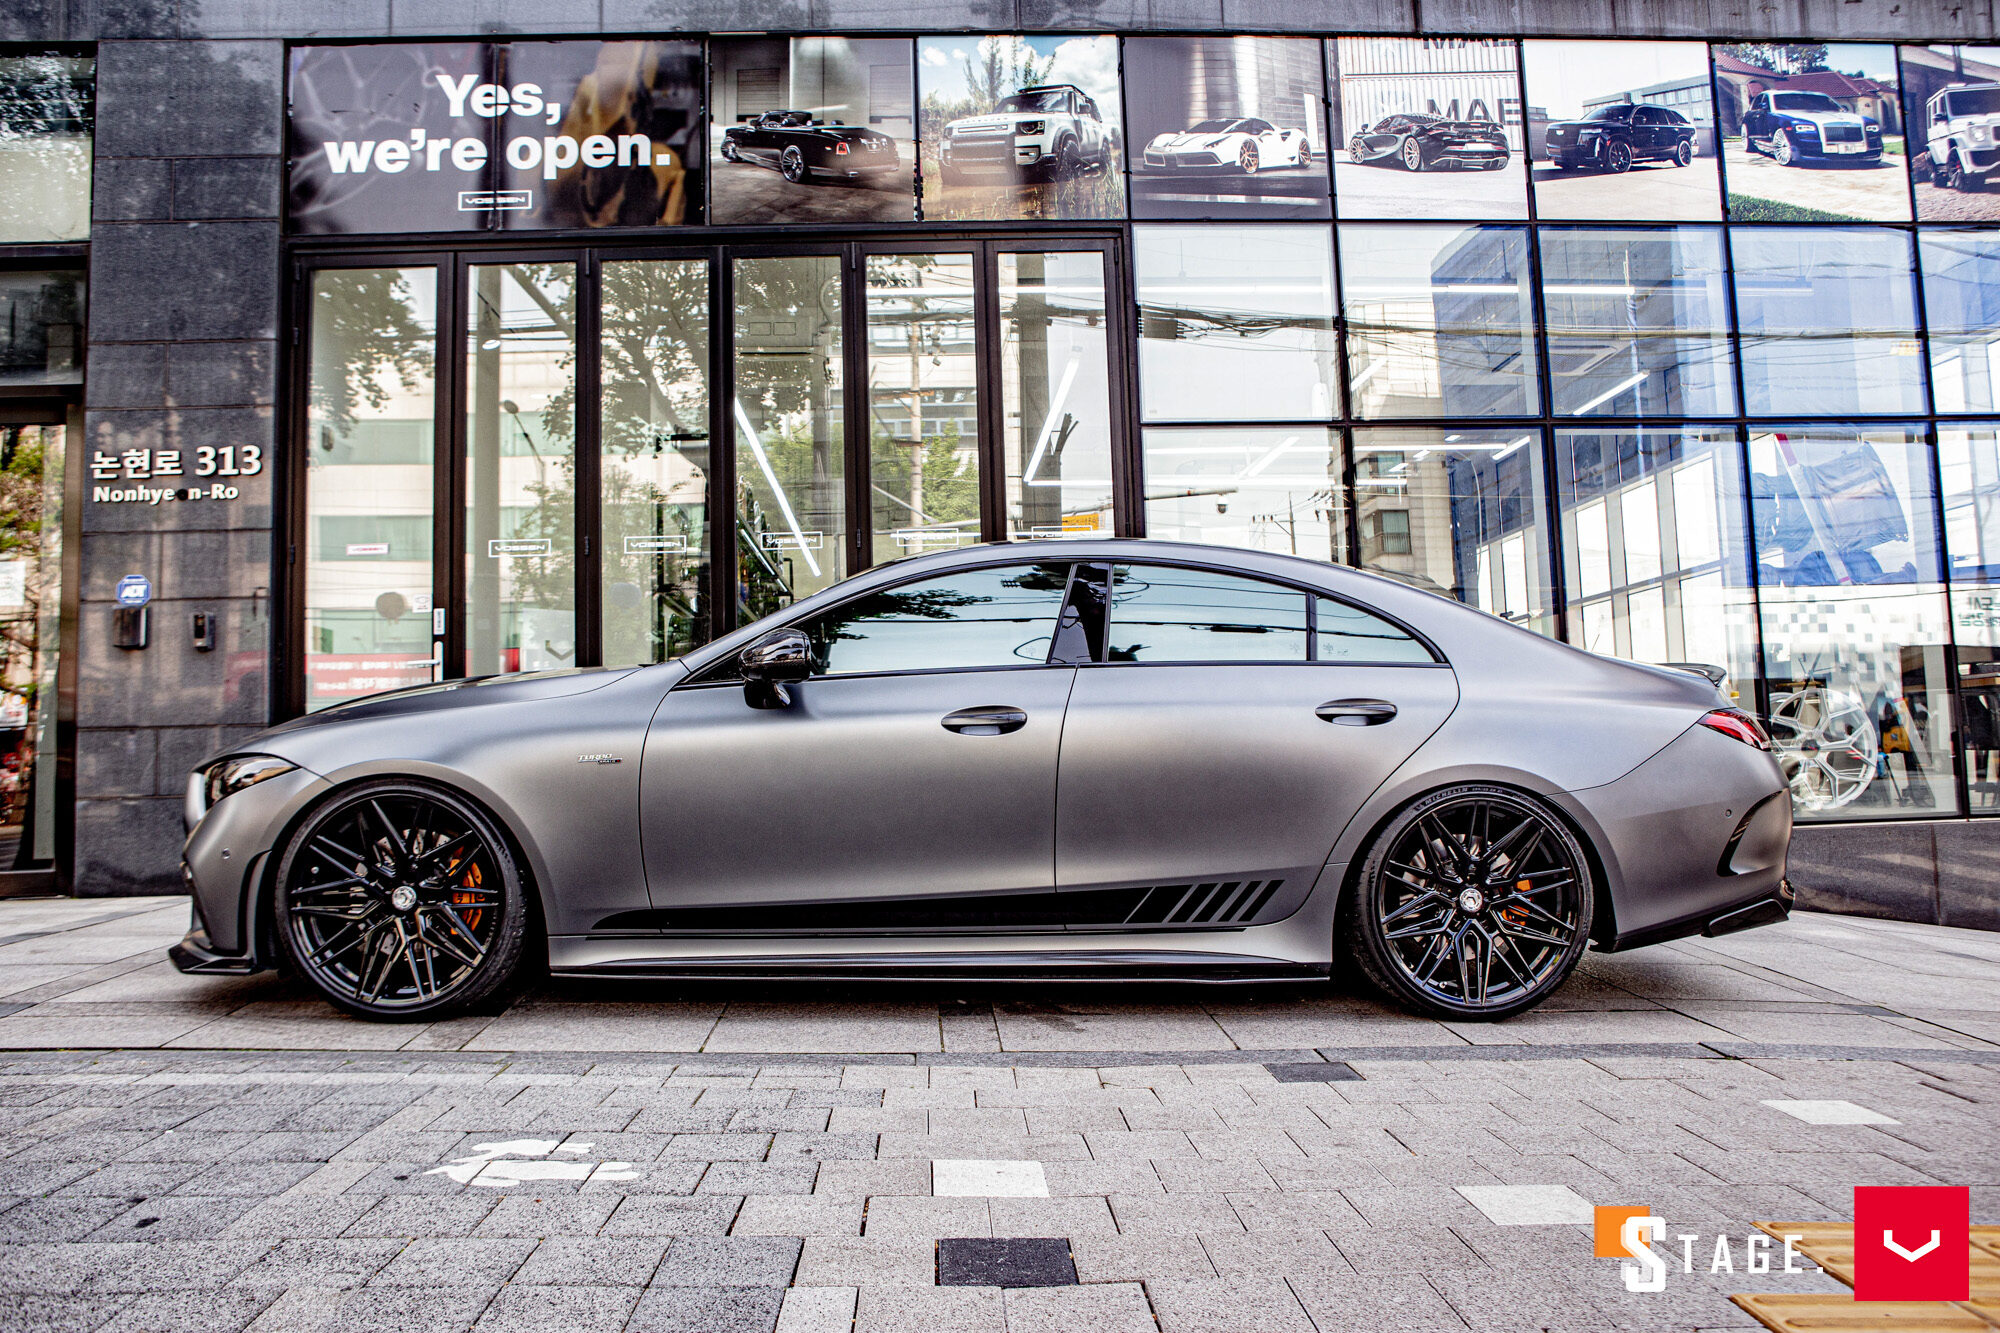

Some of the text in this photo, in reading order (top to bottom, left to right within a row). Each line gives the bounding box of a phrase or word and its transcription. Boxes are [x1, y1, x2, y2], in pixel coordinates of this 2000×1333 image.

[436, 74, 561, 125] Yes,
[323, 128, 671, 180] we're open.
[90, 445, 262, 479] 논현로 313
[93, 484, 239, 505] Nonhyen-Ro
[1425, 787, 1469, 805] MICHELIN
